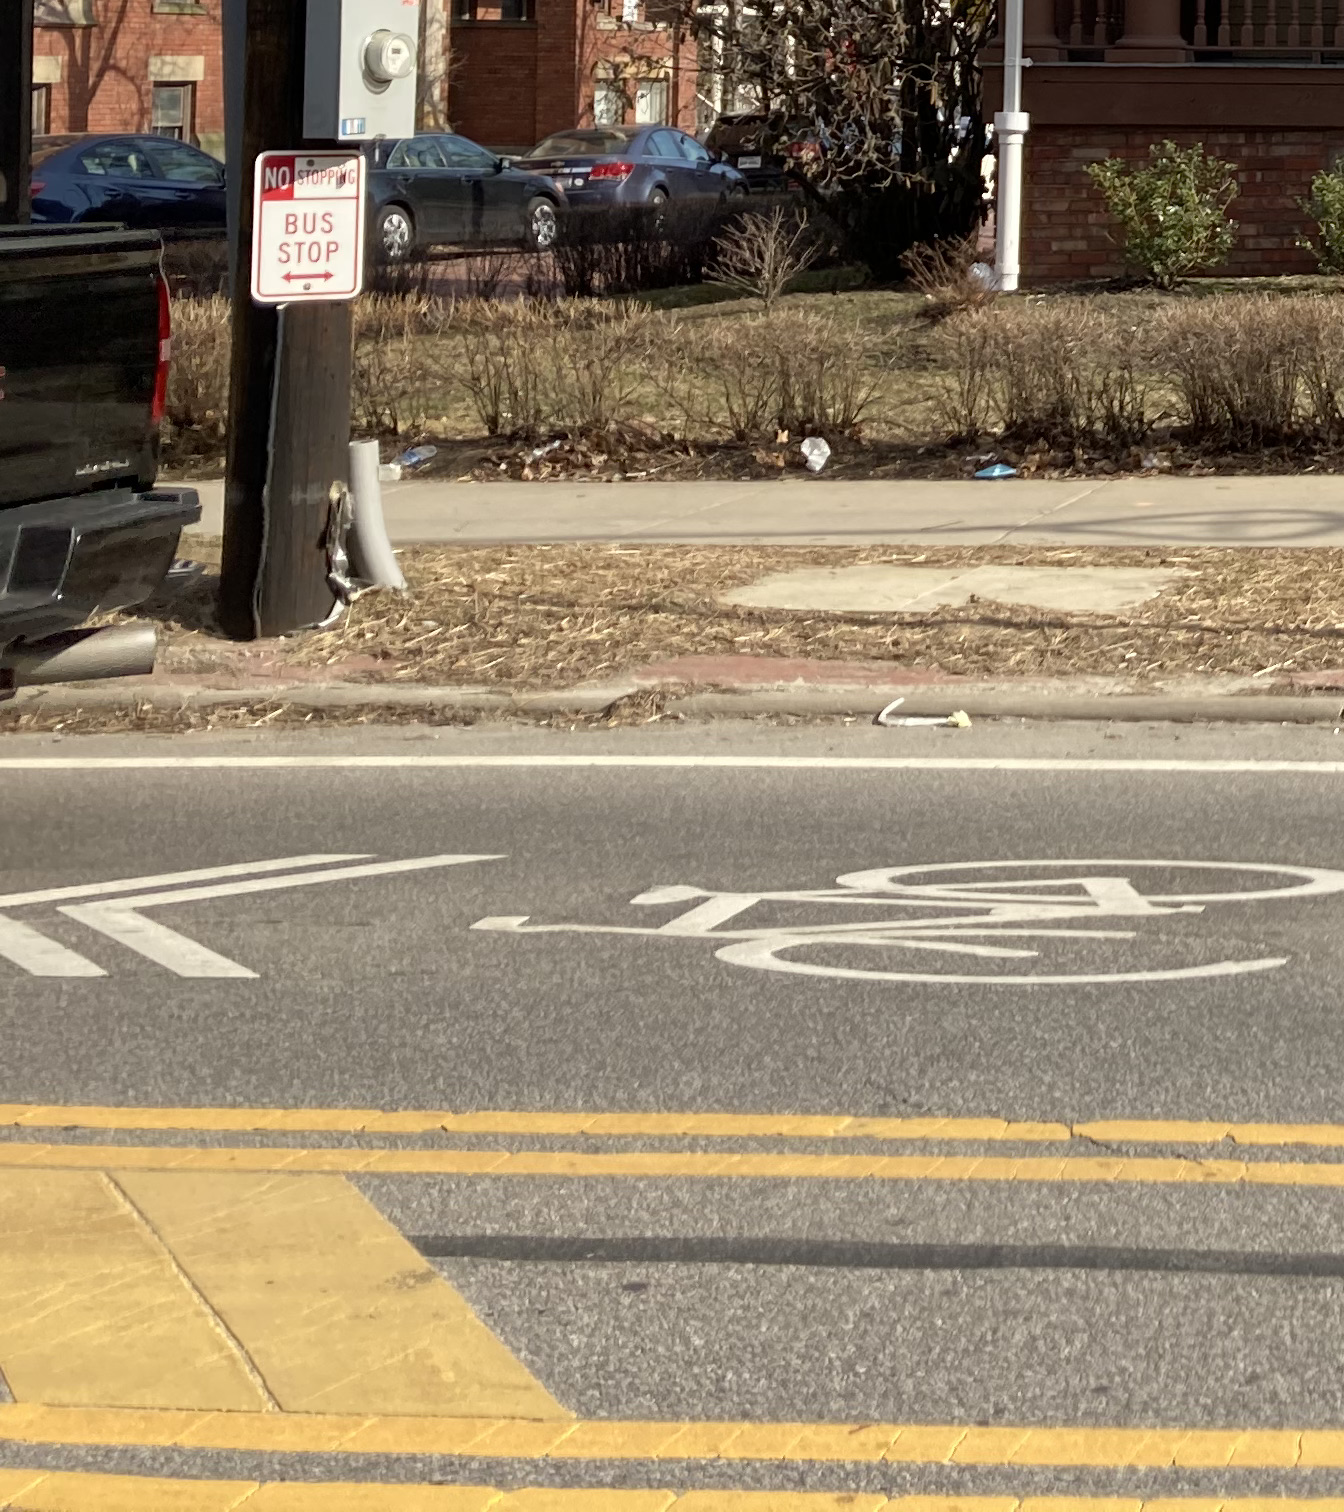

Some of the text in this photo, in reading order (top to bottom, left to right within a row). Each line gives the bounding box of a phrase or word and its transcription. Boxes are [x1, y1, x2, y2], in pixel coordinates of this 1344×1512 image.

[264, 166, 356, 191] NO STOPPING
[284, 212, 334, 235] BUS
[277, 241, 340, 264] STOP
